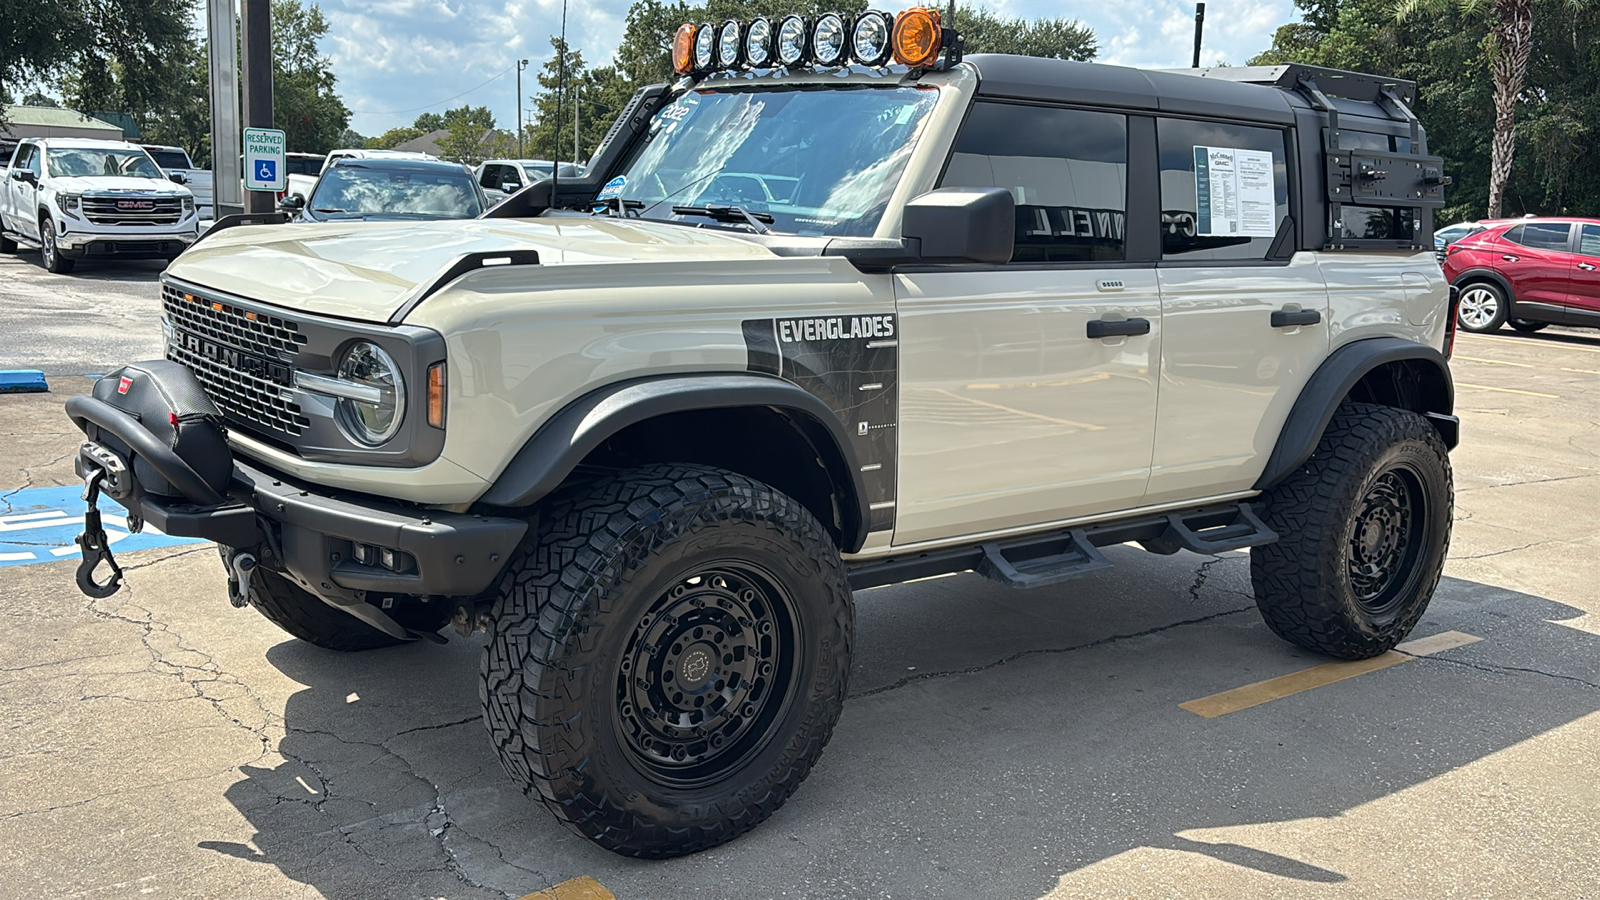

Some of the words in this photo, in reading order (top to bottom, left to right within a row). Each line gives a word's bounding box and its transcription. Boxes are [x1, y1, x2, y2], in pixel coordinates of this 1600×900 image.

[662, 105, 690, 121] 2022
[247, 134, 283, 144] RESERVED
[249, 144, 281, 155] PARKING
[117, 201, 154, 209] GMC
[779, 316, 894, 342] EVERGLADES
[174, 330, 291, 386] BRONCO
